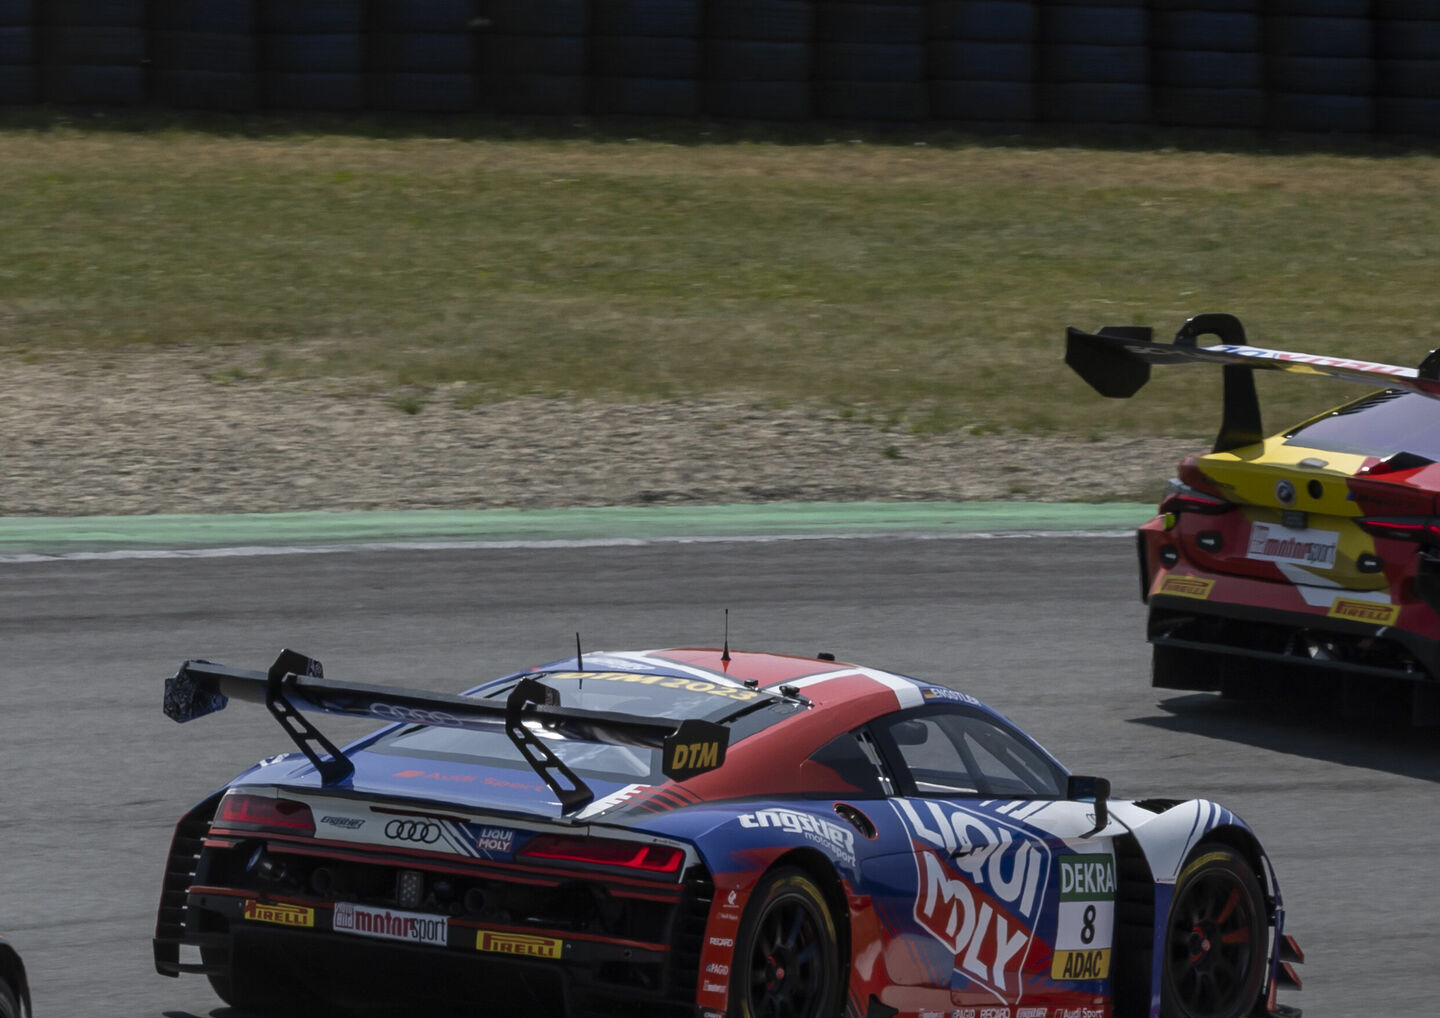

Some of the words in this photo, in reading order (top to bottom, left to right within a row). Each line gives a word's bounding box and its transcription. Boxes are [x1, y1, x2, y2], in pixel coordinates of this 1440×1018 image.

[1336, 601, 1393, 621] PIRELLI
[552, 672, 659, 689] DTM
[660, 679, 758, 700] 2023
[672, 742, 718, 770] DTM
[478, 838, 510, 851] MOLY
[482, 829, 513, 841] LIQUI
[898, 798, 1042, 919] LIQUI
[1061, 862, 1117, 894] DEKRA
[244, 900, 309, 925] PIRELLI
[923, 850, 1029, 992] MOLY
[1080, 904, 1097, 945] 8
[355, 911, 447, 943] motorsport
[482, 932, 556, 957] PIRELLI
[1063, 951, 1103, 979] ADAC
